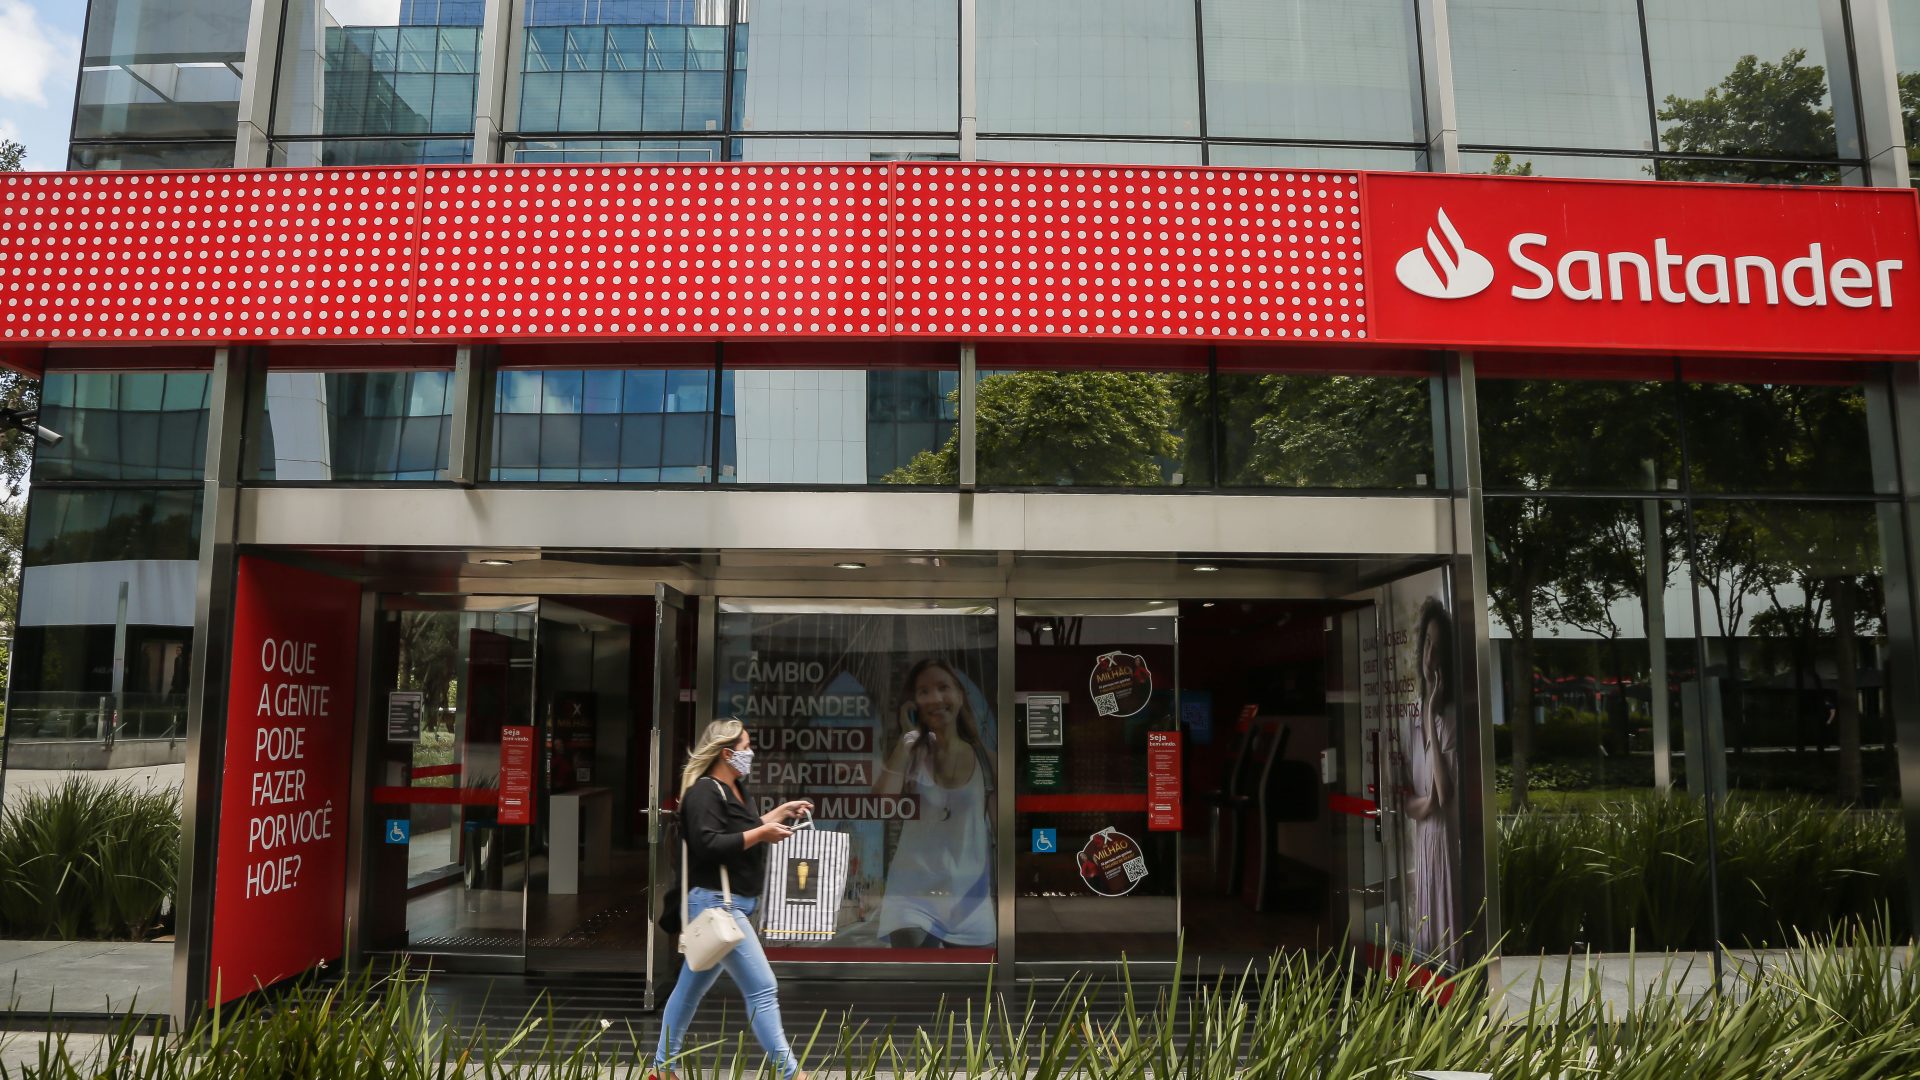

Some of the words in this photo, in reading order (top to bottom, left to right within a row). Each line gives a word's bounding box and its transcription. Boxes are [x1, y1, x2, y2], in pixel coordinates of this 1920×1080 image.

[1508, 232, 1903, 308] Santander
[262, 638, 276, 672] O
[280, 639, 317, 676] QUE
[732, 655, 824, 683] CÂMBIO
[257, 683, 271, 716] A
[275, 683, 330, 717] GENTE
[731, 694, 871, 717] SANTANDER
[255, 727, 306, 762] PODE
[503, 728, 520, 737] Seja
[749, 728, 775, 750] EU
[782, 728, 865, 751] PONTO
[1149, 733, 1167, 742] Seja
[251, 769, 306, 806] FAZER
[768, 763, 867, 785] PARTIDA
[821, 797, 916, 819] MUNDO
[249, 814, 287, 852] POR
[290, 799, 333, 844] VOCÊ
[246, 854, 302, 899] HOJE?
